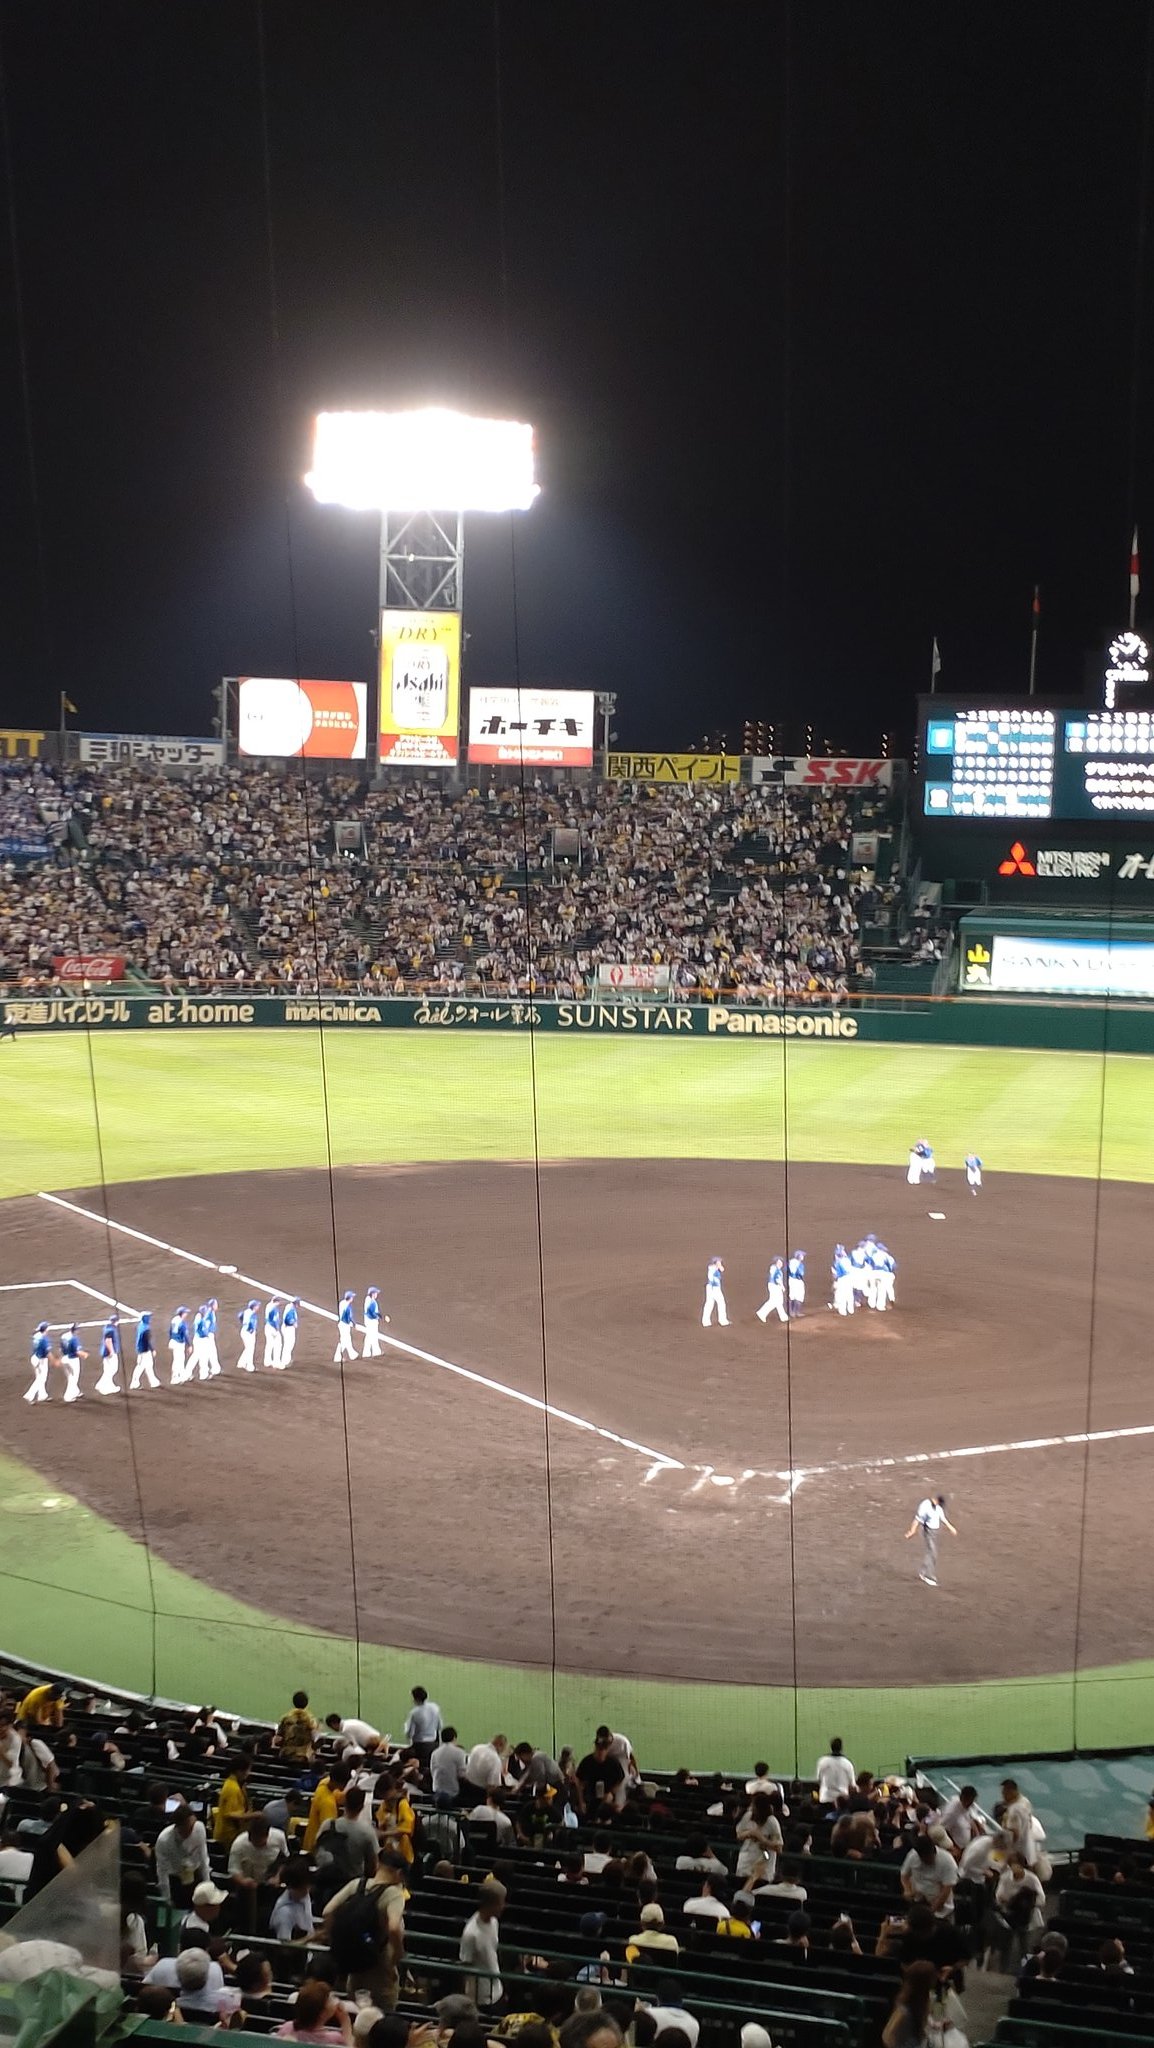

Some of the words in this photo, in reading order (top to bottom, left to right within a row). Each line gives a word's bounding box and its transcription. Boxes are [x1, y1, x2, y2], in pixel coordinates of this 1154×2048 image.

[396, 673, 444, 691] Asahi
[480, 716, 583, 737] ホーチキ
[90, 740, 214, 764] 三和シャッター
[608, 756, 738, 783] 関西ペイント
[802, 761, 886, 785] SSK
[1037, 851, 1110, 867] MITSUBISHI
[1037, 863, 1100, 877] ELECTRIC
[176, 1000, 254, 1024] home
[557, 1006, 694, 1030] SUNSTAR
[707, 1008, 858, 1037] Panasonic
